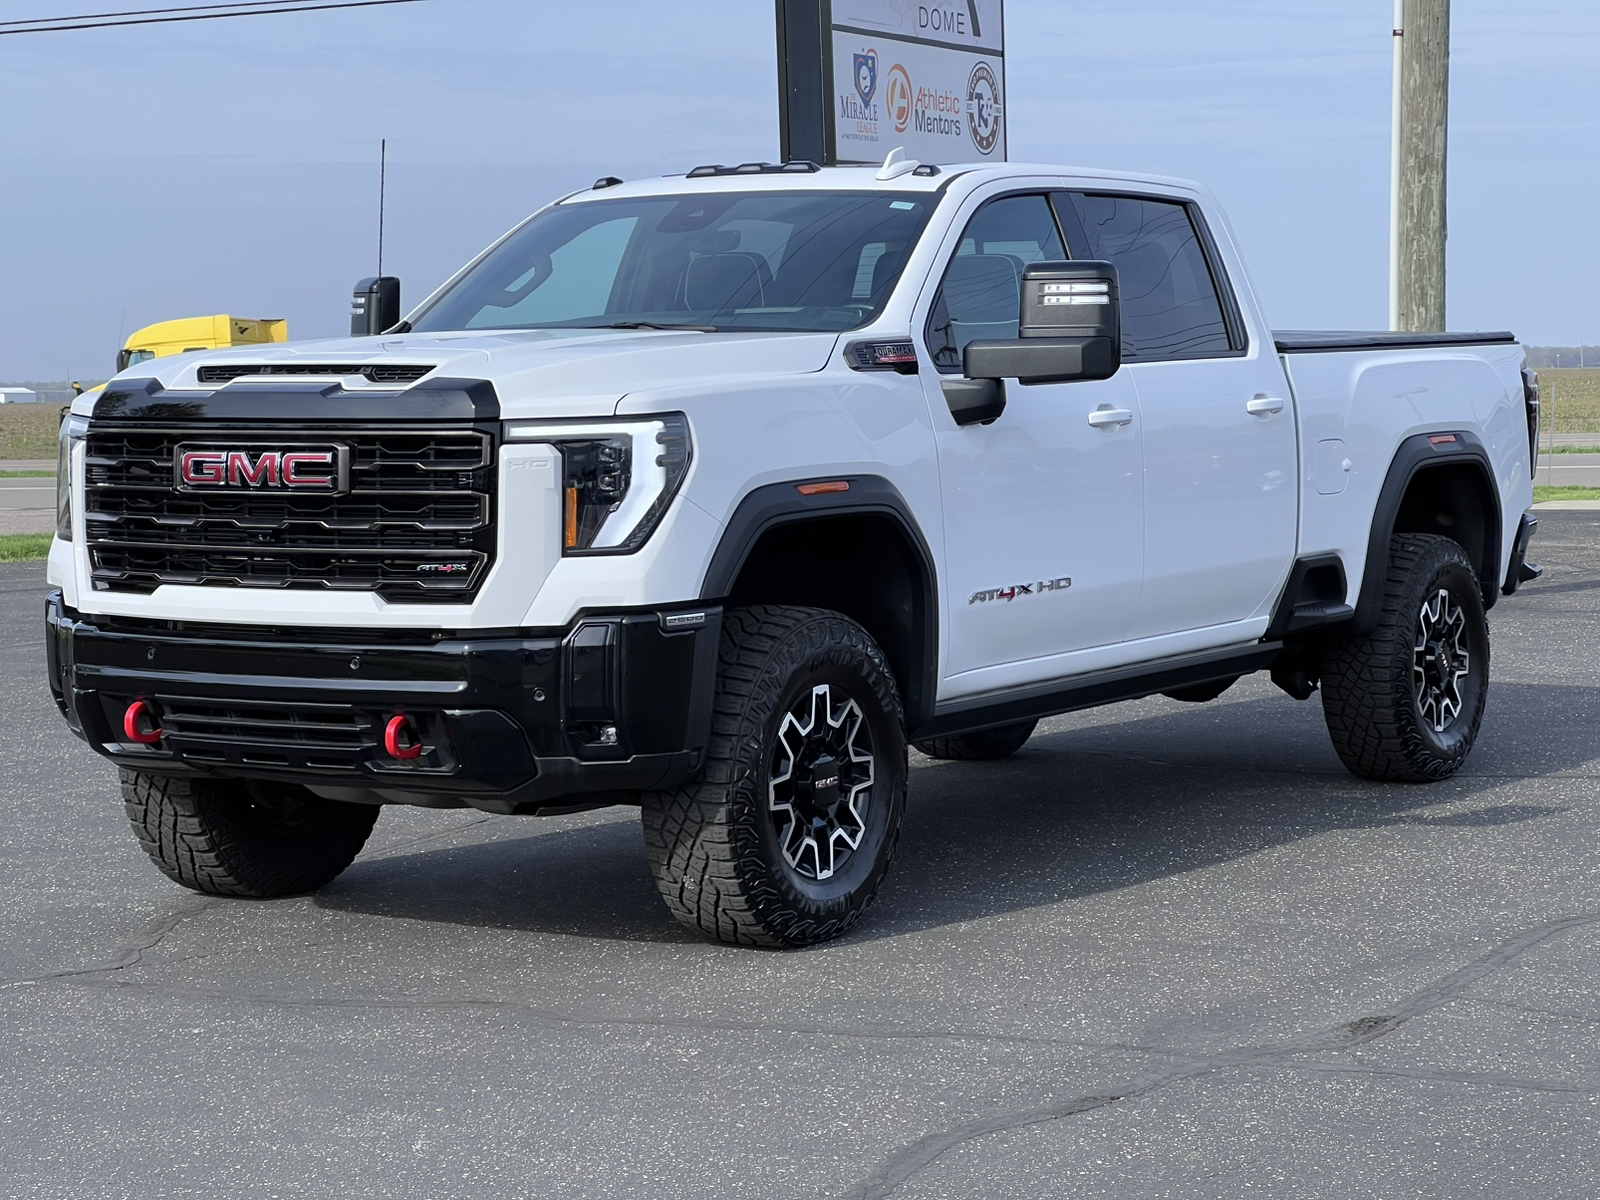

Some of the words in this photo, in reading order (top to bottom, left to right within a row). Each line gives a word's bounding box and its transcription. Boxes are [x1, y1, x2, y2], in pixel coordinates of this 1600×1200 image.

[918, 6, 965, 35] DOME
[840, 95, 879, 121] MIRACLE
[915, 86, 960, 114] Athletic
[856, 121, 878, 134] LEAGUE
[915, 109, 961, 136] Mentors
[877, 345, 913, 356] DURAMAX
[182, 451, 335, 488] GMC
[508, 460, 550, 470] HD
[416, 563, 468, 573] AT4X
[968, 582, 1034, 605] AT4X
[1037, 577, 1072, 593] HD
[667, 615, 703, 624] 2500
